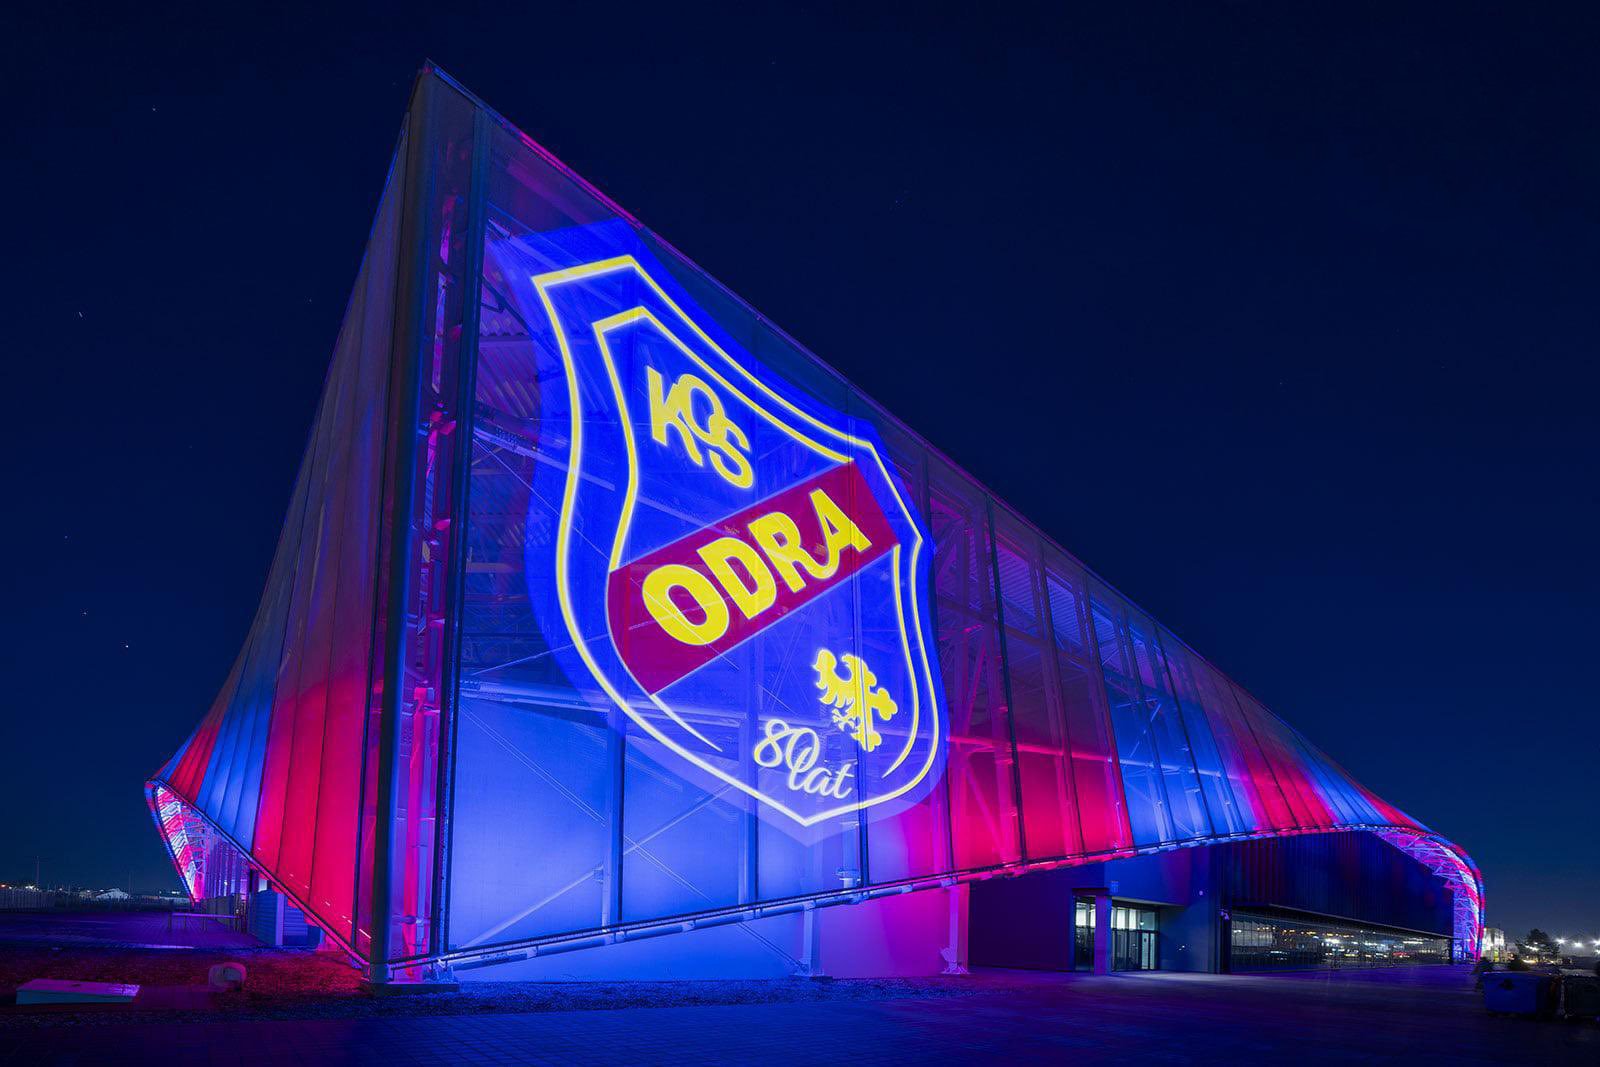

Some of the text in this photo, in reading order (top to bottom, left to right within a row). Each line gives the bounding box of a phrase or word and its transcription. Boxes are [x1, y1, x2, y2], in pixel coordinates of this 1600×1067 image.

[641, 488, 872, 646] ODRA
[753, 718, 820, 770] 80
[788, 746, 855, 799] lat
